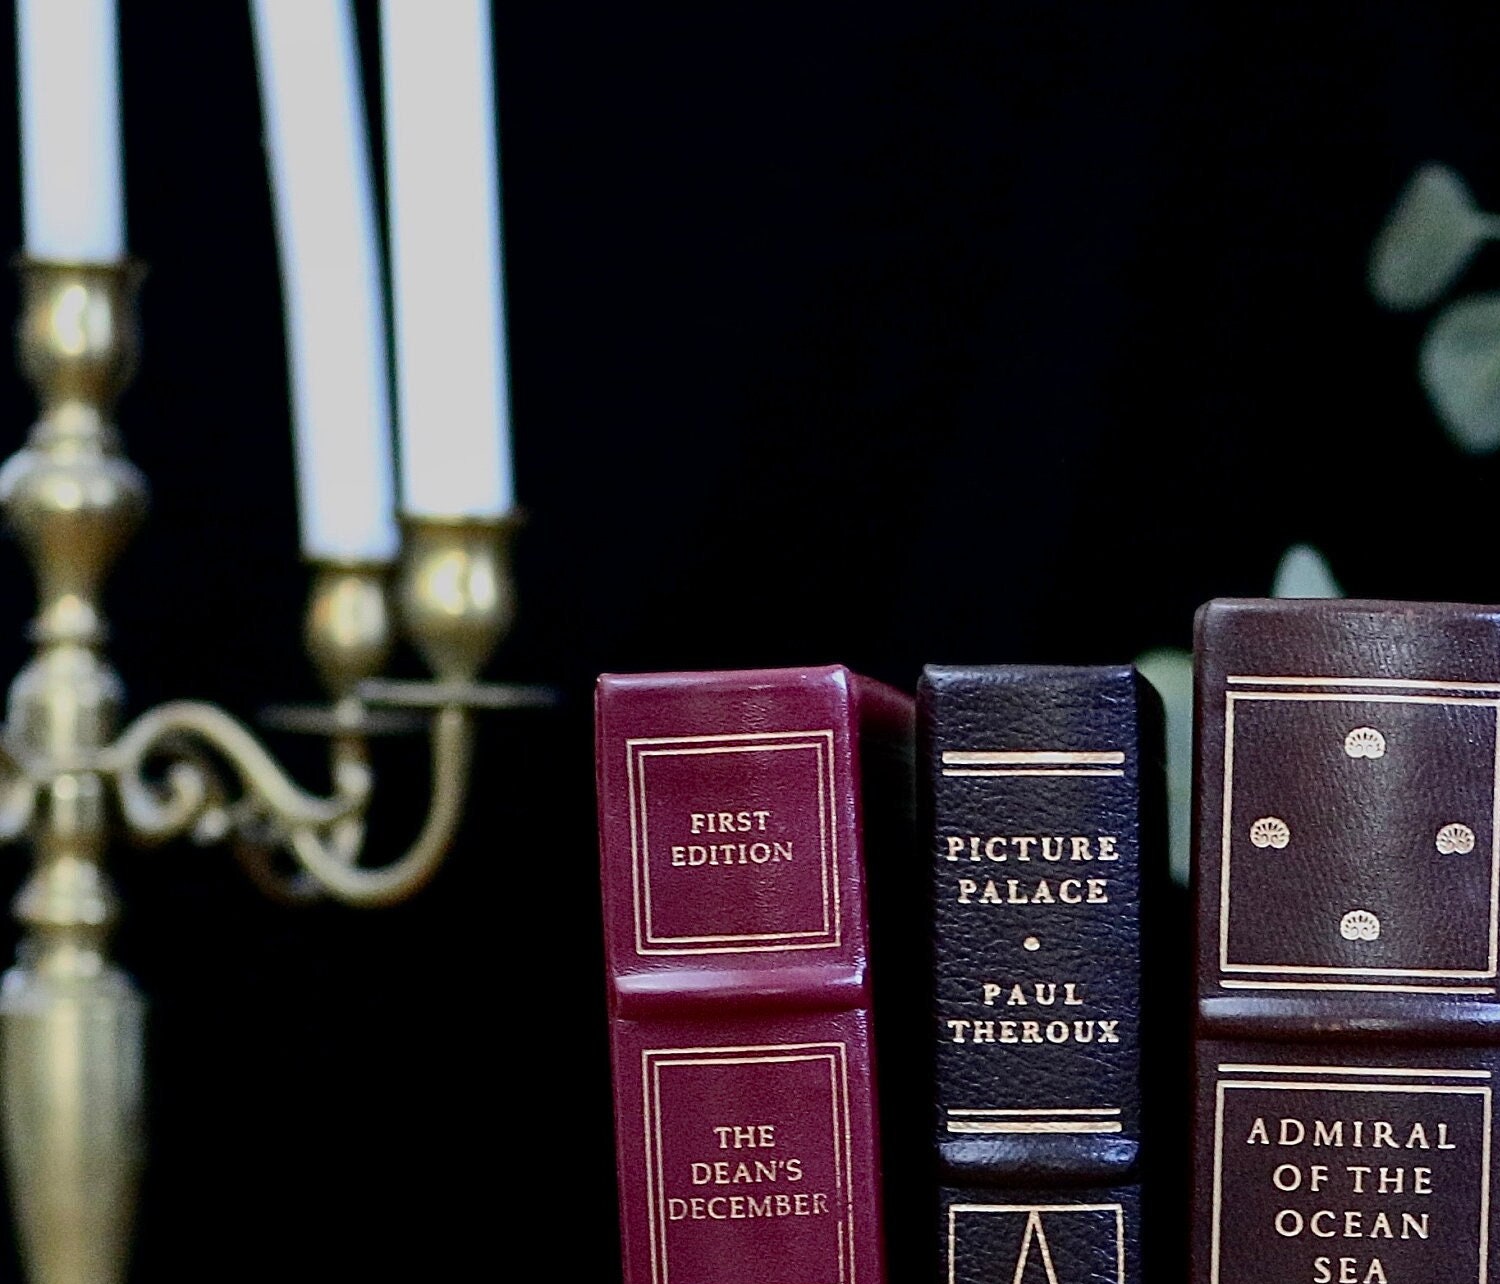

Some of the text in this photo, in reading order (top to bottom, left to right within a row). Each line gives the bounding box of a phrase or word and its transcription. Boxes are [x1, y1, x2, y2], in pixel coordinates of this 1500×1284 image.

[690, 812, 771, 834] FIRST
[671, 841, 793, 867] EDITION
[946, 836, 1119, 862] PICTURE
[957, 880, 1108, 904] PALACE
[983, 984, 1084, 1006] PAUL
[948, 1021, 1120, 1043] THEROUX
[714, 1125, 775, 1149] THE
[1247, 1118, 1456, 1149] ADMIRAL
[691, 1159, 802, 1186] DEAN'S
[1272, 1165, 1433, 1195] OF THE
[668, 1193, 829, 1221] DECEMBER
[1274, 1209, 1430, 1239] OCEAN
[1313, 1257, 1388, 1284] SEA
